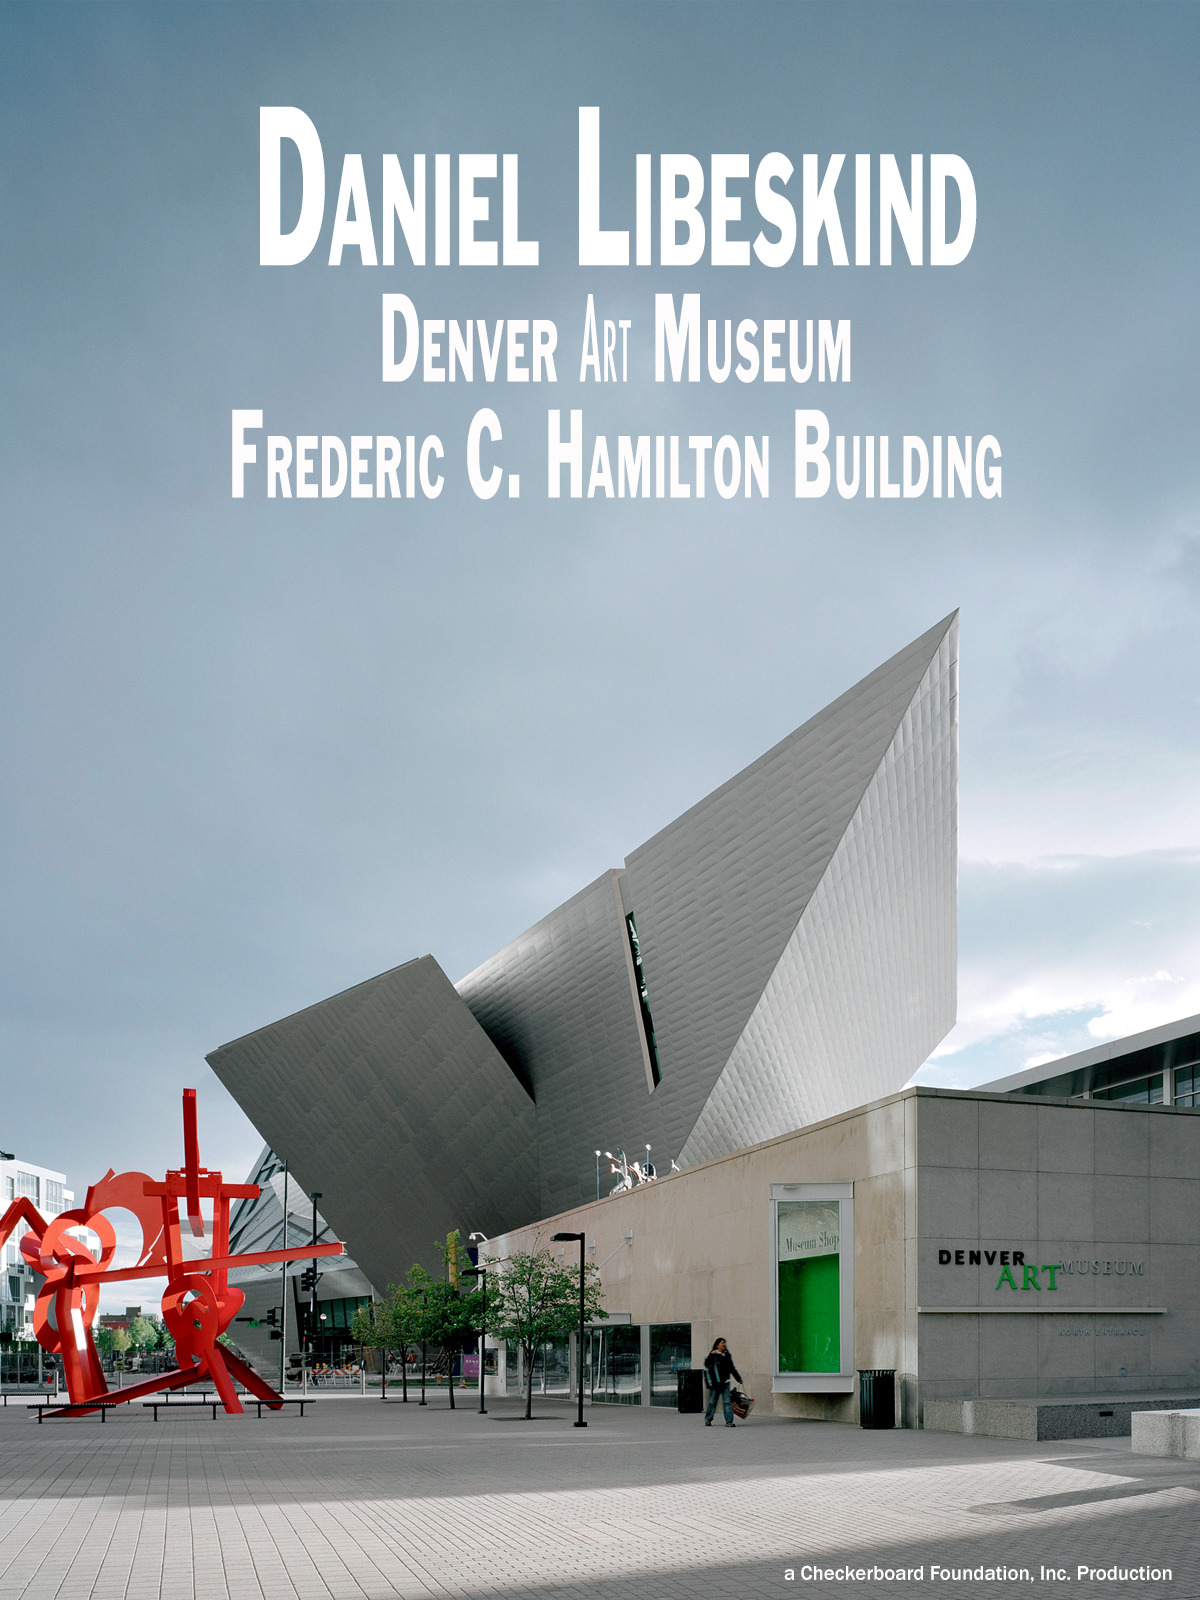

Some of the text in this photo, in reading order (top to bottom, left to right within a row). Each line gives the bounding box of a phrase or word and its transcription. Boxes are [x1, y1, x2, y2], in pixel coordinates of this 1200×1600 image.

[785, 1231, 839, 1253] Museum Shop
[938, 1249, 1025, 1266] DENVER
[1059, 1260, 1145, 1276] MUSEUM
[995, 1264, 1062, 1290] ART
[1058, 1328, 1145, 1337] NORTH ENTRANCE
